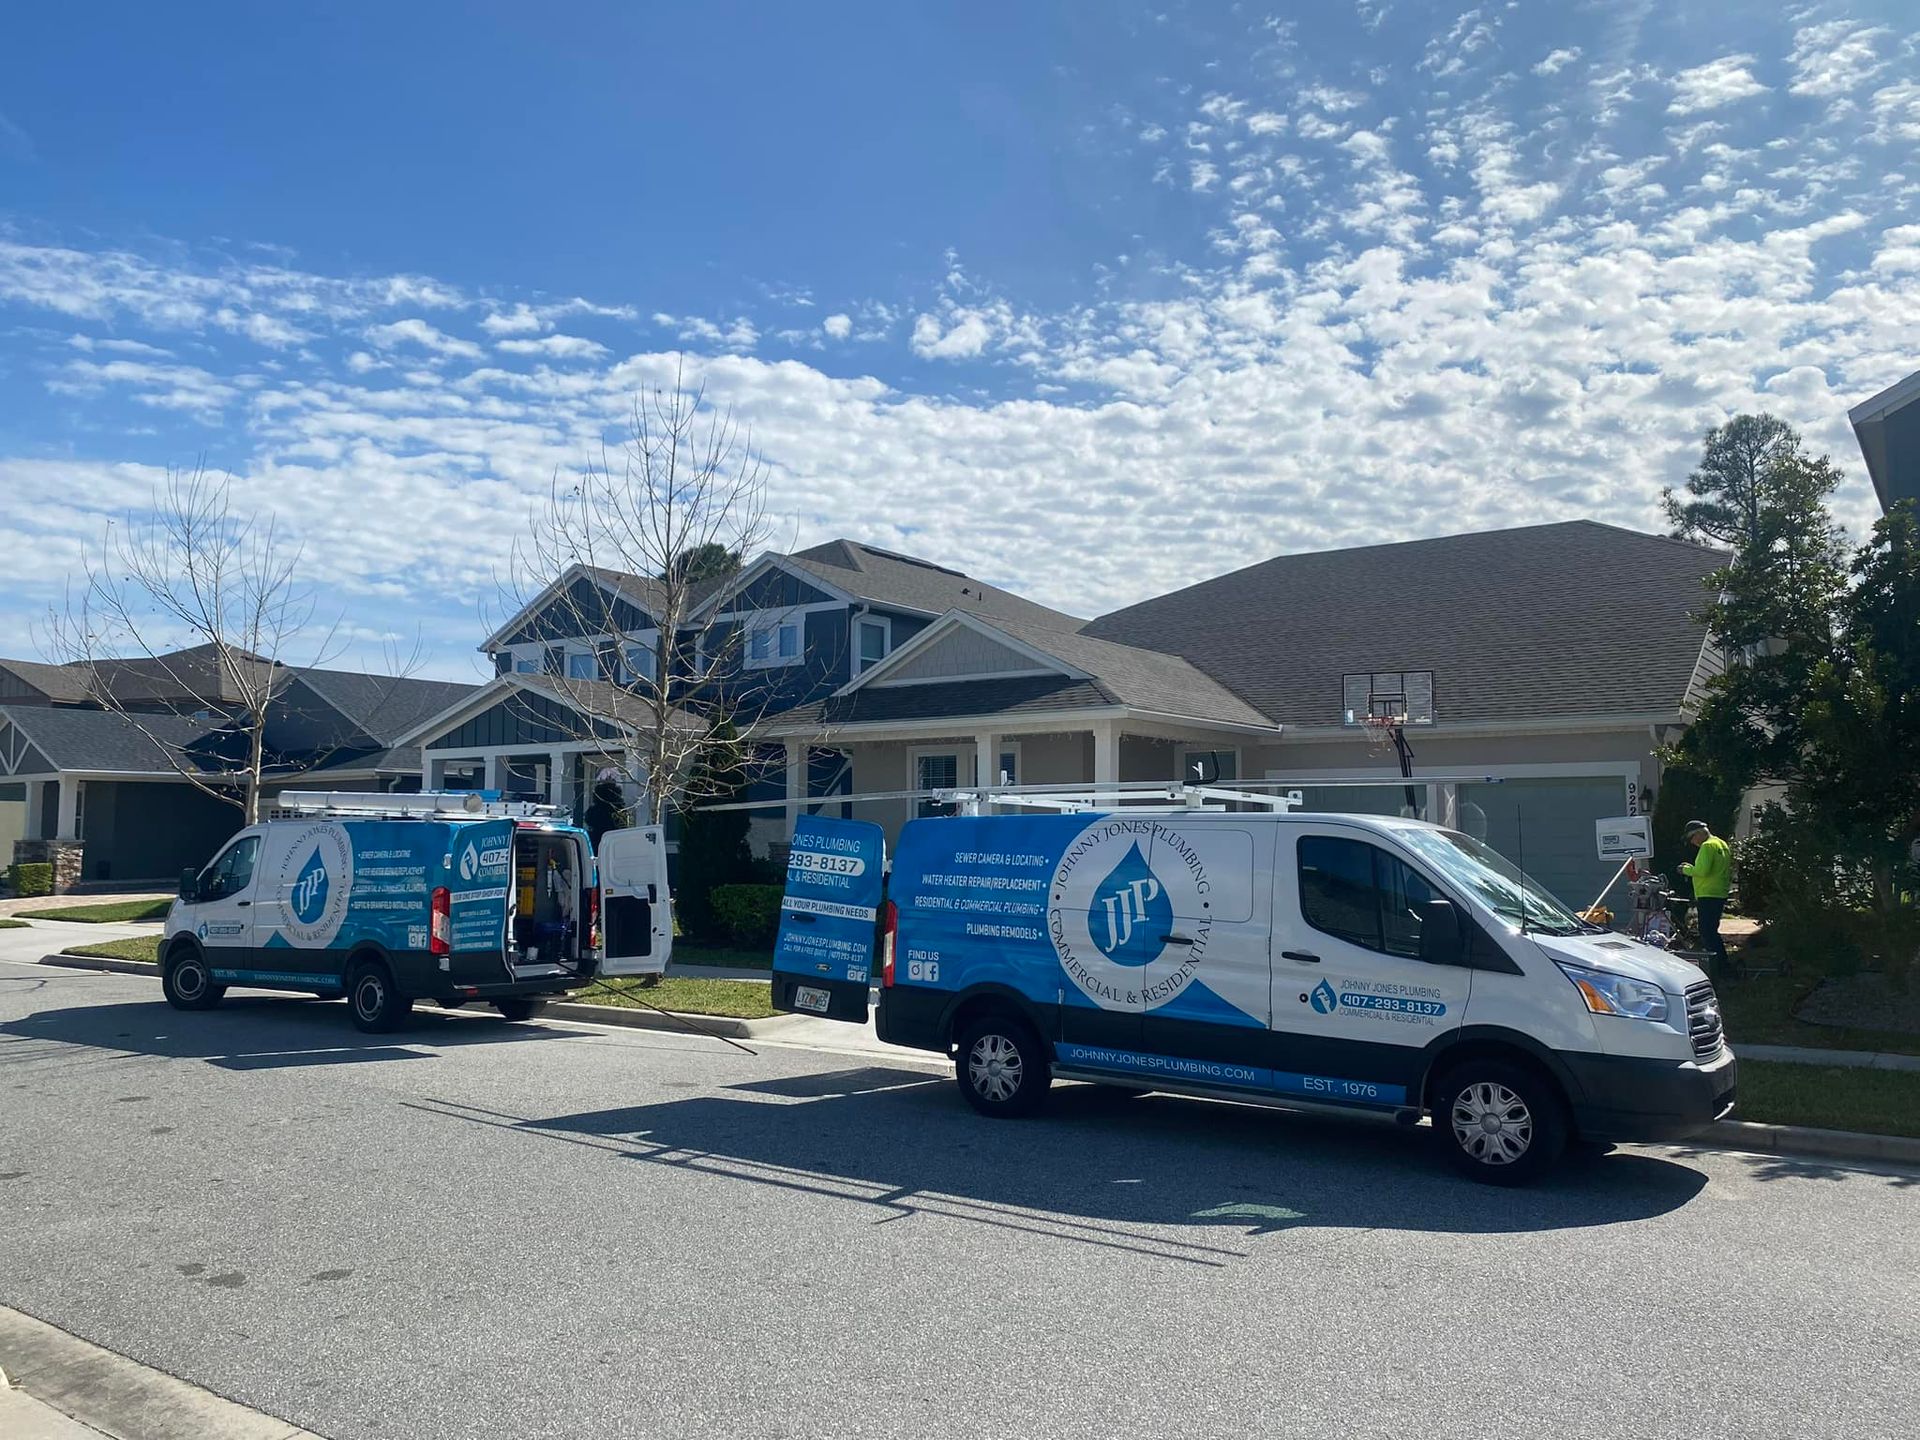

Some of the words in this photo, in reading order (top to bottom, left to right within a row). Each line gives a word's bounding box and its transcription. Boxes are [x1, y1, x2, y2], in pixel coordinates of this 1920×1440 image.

[1628, 783, 1638, 817] 922
[815, 836, 861, 853] PLUMBING
[955, 852, 977, 864] SEWER
[978, 853, 1005, 865] CAMERA
[1005, 854, 1011, 865] &
[1011, 854, 1044, 867] LOCATING
[1057, 830, 1102, 890] JOHNNY
[1103, 820, 1150, 841] JONES
[1153, 823, 1211, 895] PLUMBING
[801, 871, 850, 889] RESIDENTIAL
[922, 873, 943, 886] WATER
[944, 874, 968, 887] HEATER
[968, 875, 1041, 891] REPAIR/REPLACEMENT
[299, 868, 325, 916] JJP
[793, 899, 811, 910] YOUR
[811, 901, 845, 915] PLUMBING
[845, 908, 869, 918] NEEDS
[914, 895, 953, 909] RESIDENTIAL
[954, 898, 960, 909] &
[960, 899, 1003, 913] COMMERCIAL
[1003, 901, 1040, 915] PLUMBING
[1102, 878, 1159, 953] JJP
[966, 923, 1000, 937] PLUMBING
[1001, 925, 1037, 940] REMODELS
[783, 932, 867, 953] JOHNNYJONESPLUMBING.COM
[908, 949, 927, 960] FIND
[927, 951, 939, 961] US
[1050, 908, 1121, 1002] COMMERCIAL
[1126, 990, 1139, 1004] &
[1140, 914, 1213, 1003] RESIDENTIAL
[1340, 979, 1371, 992] JOHNNY
[1372, 982, 1398, 995] JONES
[1400, 984, 1441, 999] PLUMBING
[1343, 994, 1441, 1015] 407-293-8137
[1339, 1007, 1384, 1021] COMMERCIAL
[1385, 1012, 1391, 1021] &
[1391, 1013, 1435, 1026] RESIDENTIAL
[1070, 1048, 1255, 1081] JOHNNYJONESPLUMBING.COM
[1303, 1077, 1338, 1093] EST.
[1342, 1082, 1377, 1097] 1976
